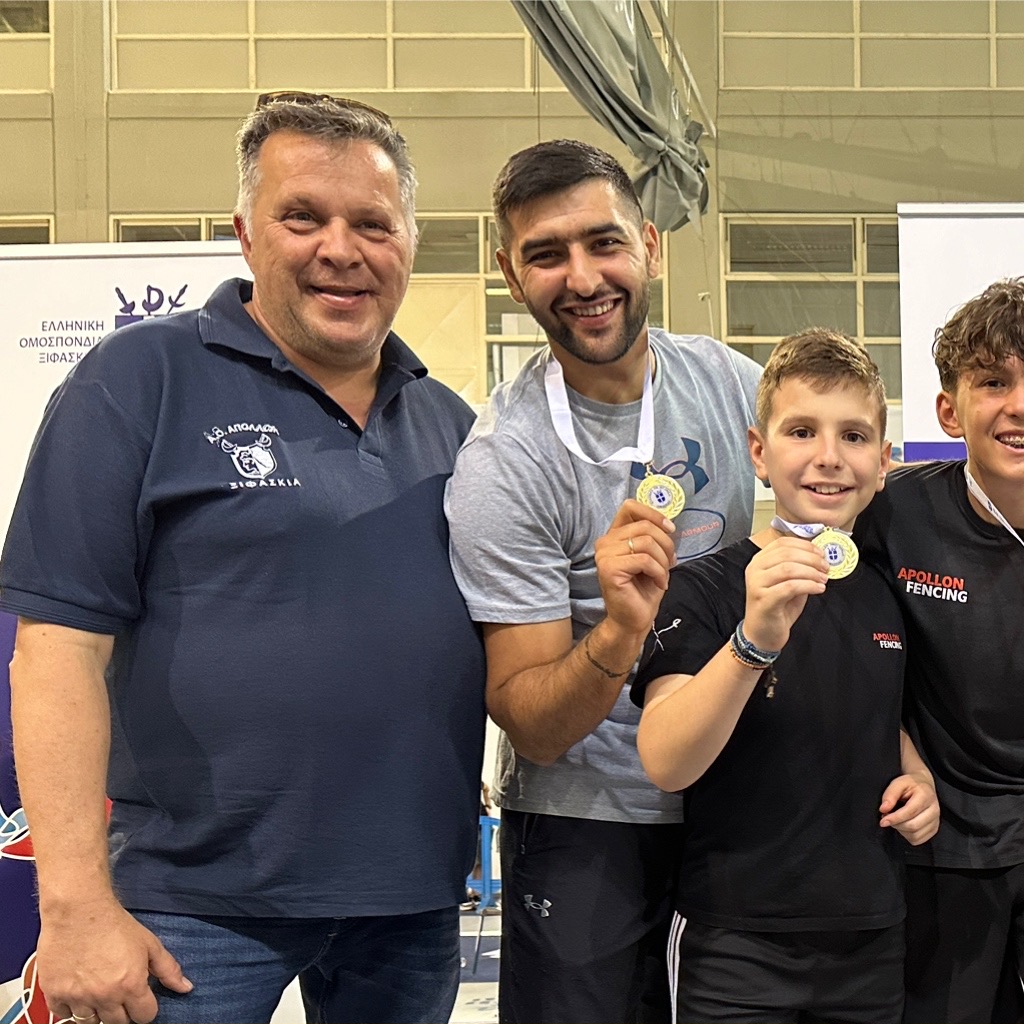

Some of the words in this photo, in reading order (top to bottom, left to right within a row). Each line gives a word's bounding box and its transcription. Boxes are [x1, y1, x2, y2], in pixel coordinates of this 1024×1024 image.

[41, 320, 104, 332] ΕΛΛΗΝΙΚΗ
[39, 352, 83, 364] ΞΙΦΑΣΚ
[229, 477, 302, 490] ΞΙΦΑΣΚΙΑ
[897, 567, 964, 591] APOLLON
[906, 581, 968, 603] FENCING
